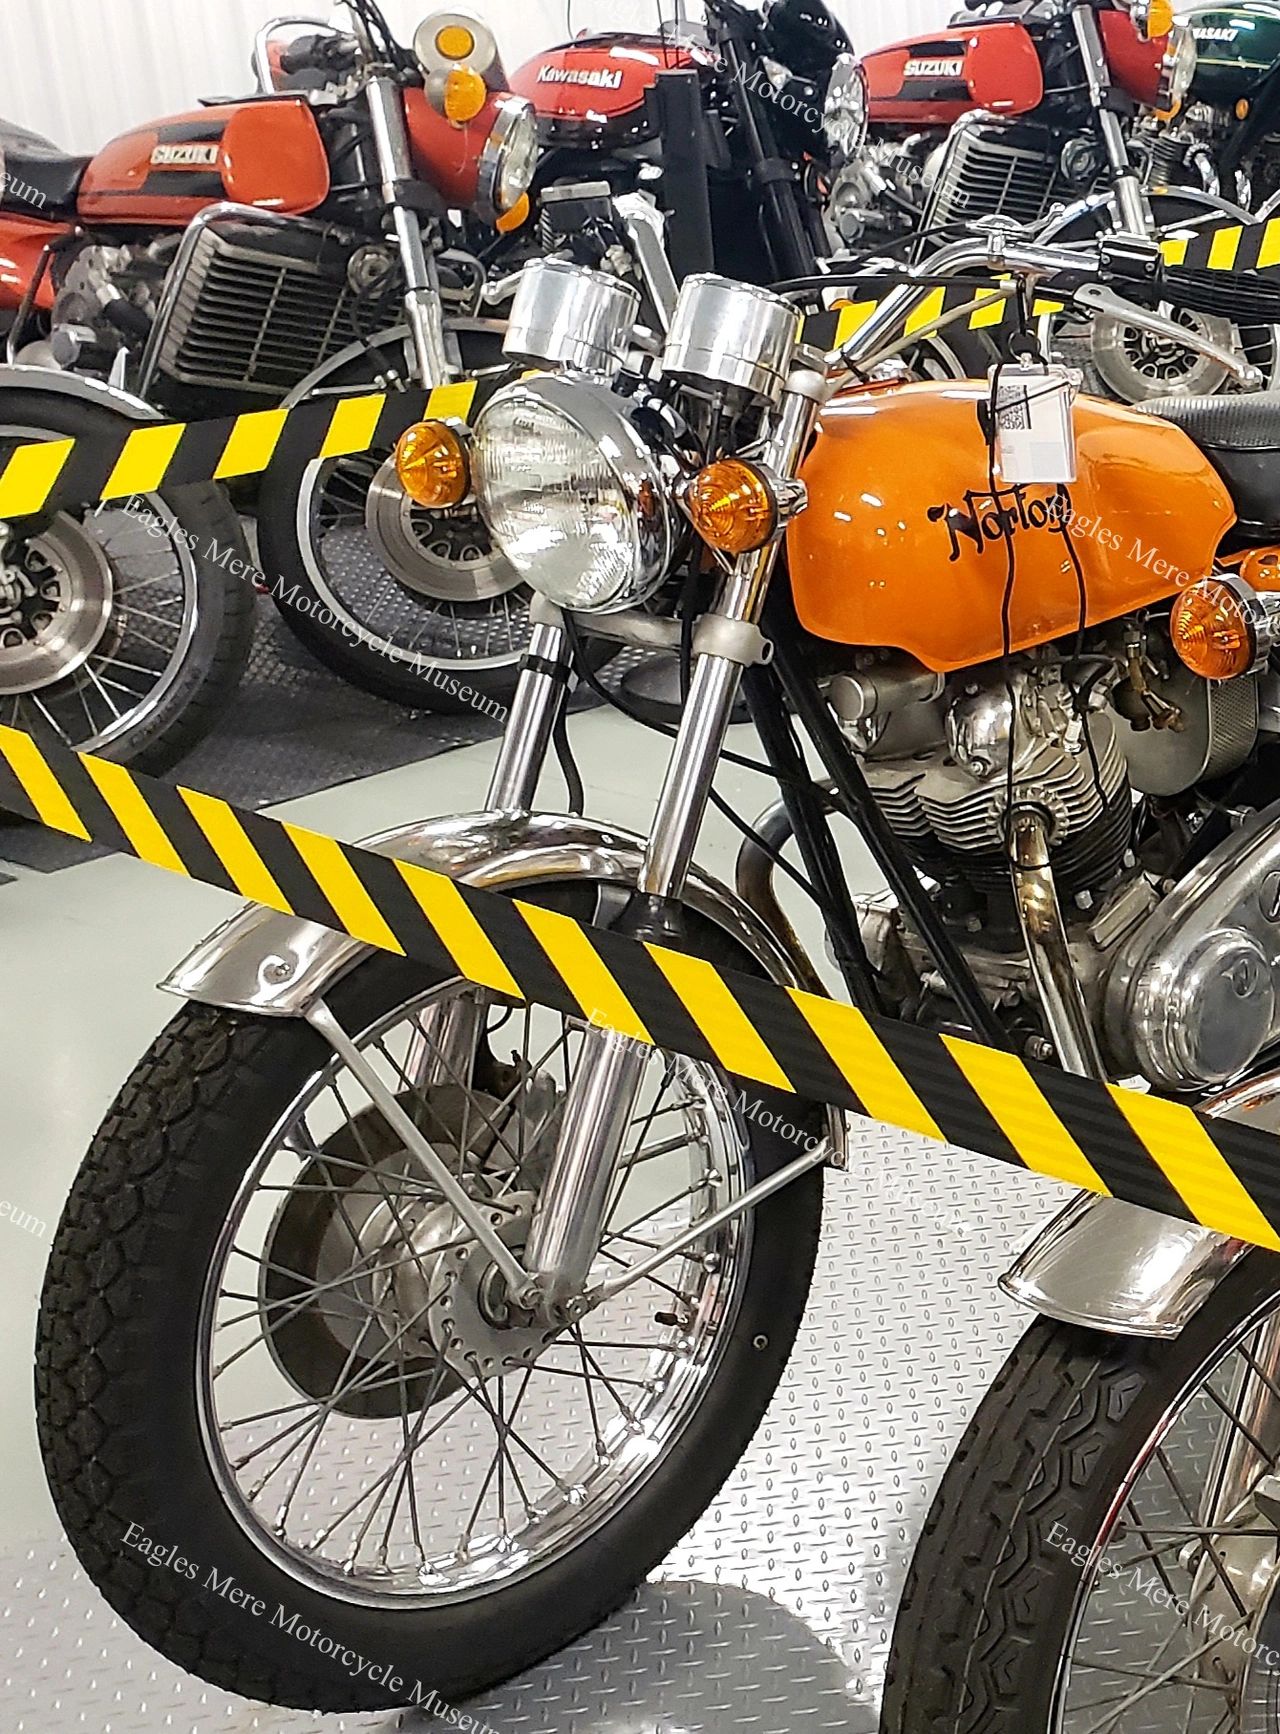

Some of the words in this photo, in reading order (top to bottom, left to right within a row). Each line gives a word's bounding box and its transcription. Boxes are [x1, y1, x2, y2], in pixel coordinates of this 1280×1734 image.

[536, 64, 623, 89] Kawasaki
[903, 59, 964, 77] SUZUKI
[150, 144, 219, 165] SUZUKI
[927, 483, 1072, 562] Norton
